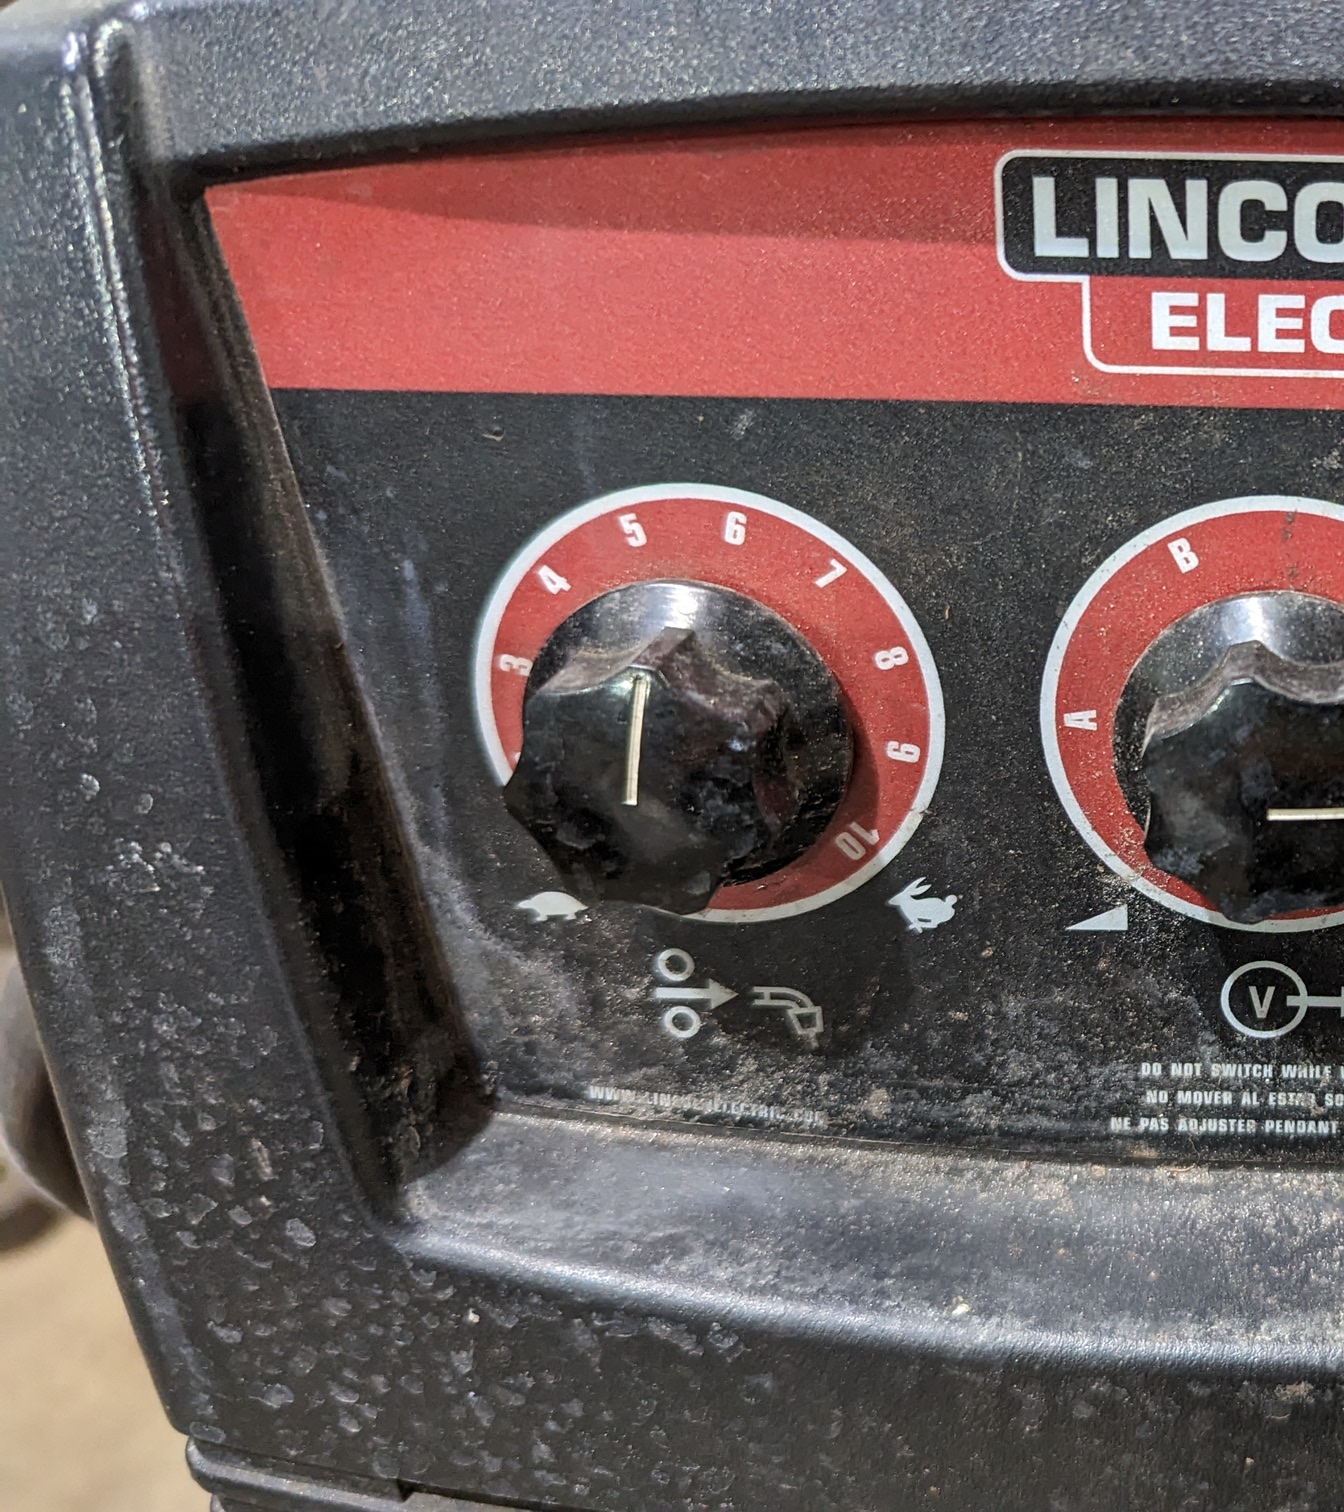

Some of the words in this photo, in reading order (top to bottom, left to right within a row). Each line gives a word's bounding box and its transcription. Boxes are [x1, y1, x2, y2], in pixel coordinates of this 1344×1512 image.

[618, 512, 648, 548] 5
[724, 510, 748, 547] 6
[1166, 537, 1200, 574] B
[537, 564, 572, 595] 4
[815, 559, 848, 589] 7
[499, 653, 534, 676] 3
[874, 645, 910, 671] 8
[1063, 709, 1098, 731] A
[886, 740, 922, 764] 9
[835, 821, 881, 862] 10
[1247, 985, 1276, 1019] V
[1141, 1062, 1162, 1076] DO
[1171, 1062, 1202, 1077] NOT
[1211, 1063, 1273, 1078] SWITCH
[1281, 1064, 1332, 1079] WHILE
[1146, 1090, 1168, 1104] NO
[1177, 1090, 1233, 1105] MOVER
[1241, 1091, 1260, 1106] AL
[1110, 1117, 1131, 1132] NE
[1140, 1117, 1169, 1132] PAS
[1178, 1118, 1256, 1133] ADJUSTER
[1265, 1120, 1339, 1134] PENDANT
